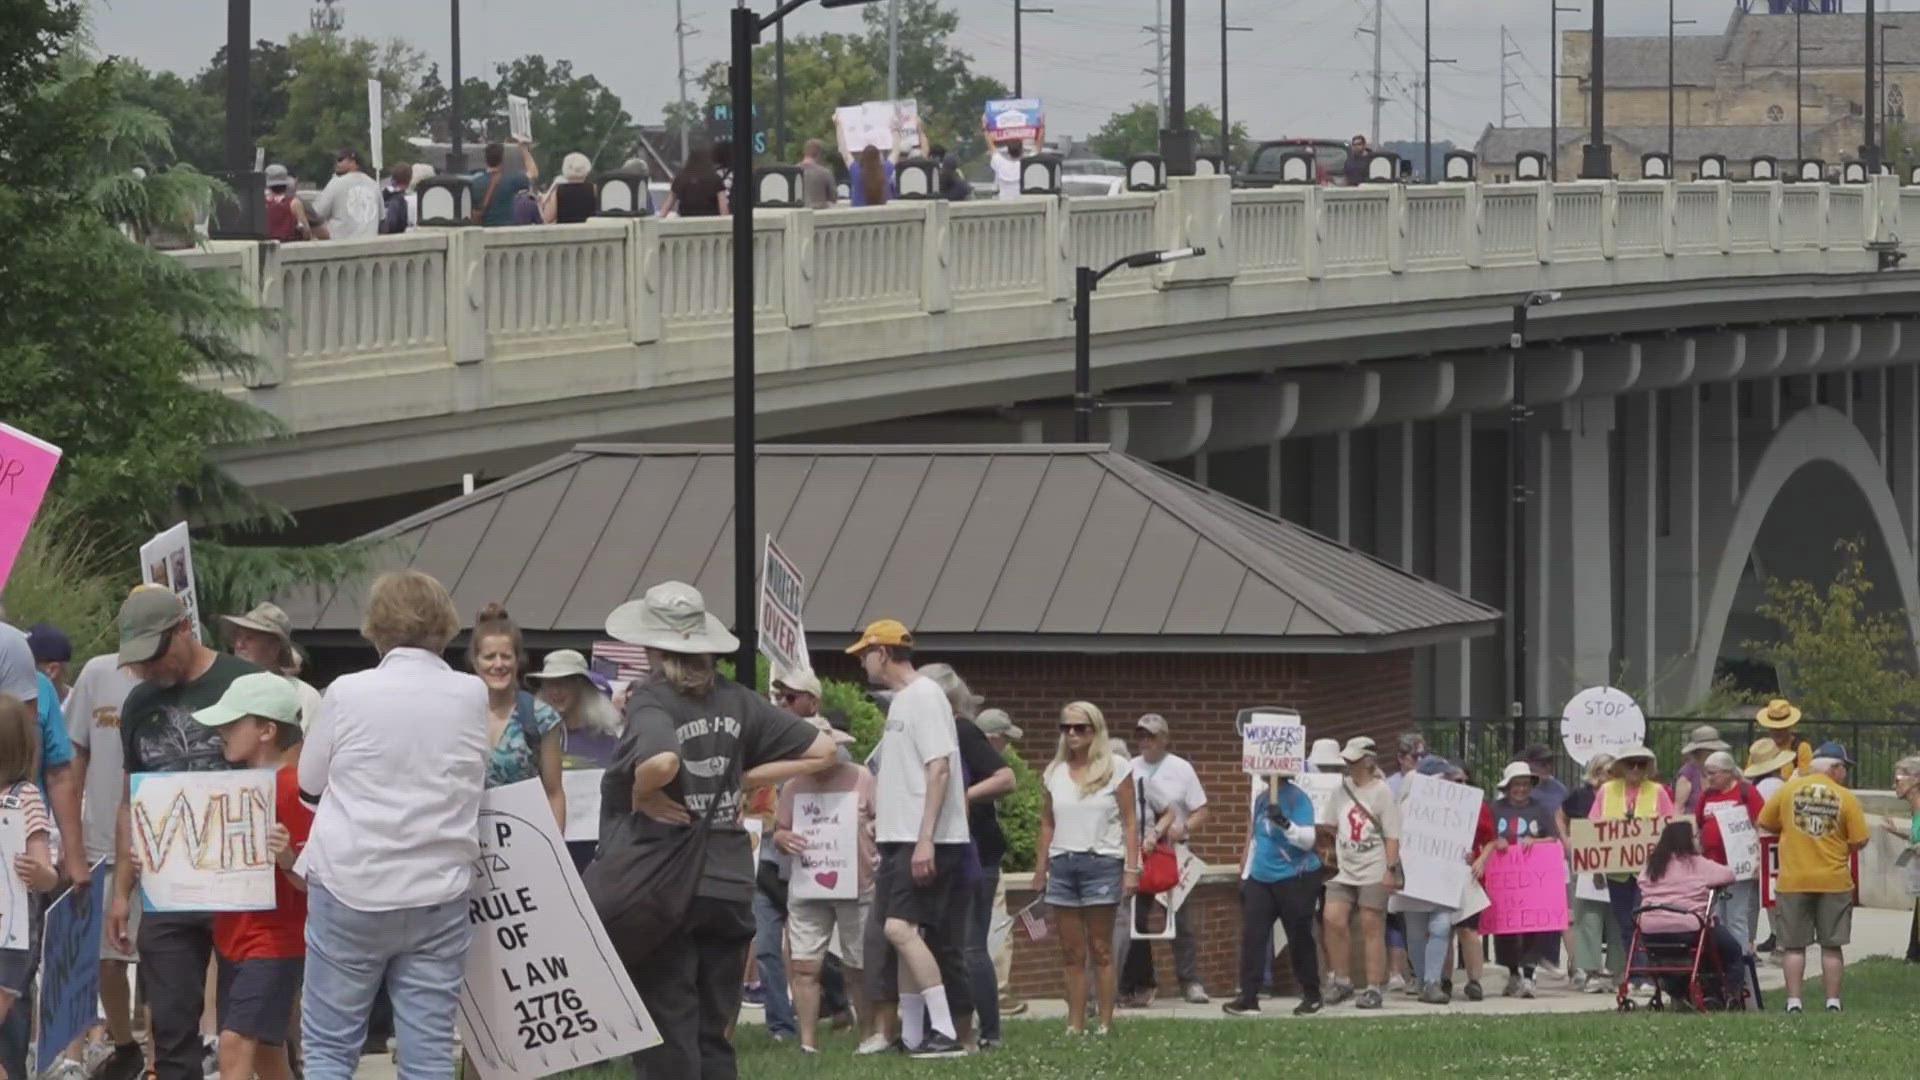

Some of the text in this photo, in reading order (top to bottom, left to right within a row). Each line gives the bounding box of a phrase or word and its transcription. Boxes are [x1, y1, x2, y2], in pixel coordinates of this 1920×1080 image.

[764, 603, 795, 660] OVER
[1584, 700, 1626, 717] STOP
[1594, 817, 1642, 842] THIS
[1573, 846, 1612, 872] NOT
[469, 887, 538, 924] RULE
[497, 923, 530, 951] OF
[501, 955, 569, 992] LAW
[514, 987, 583, 1024] 1776
[518, 1010, 598, 1050] 2025
